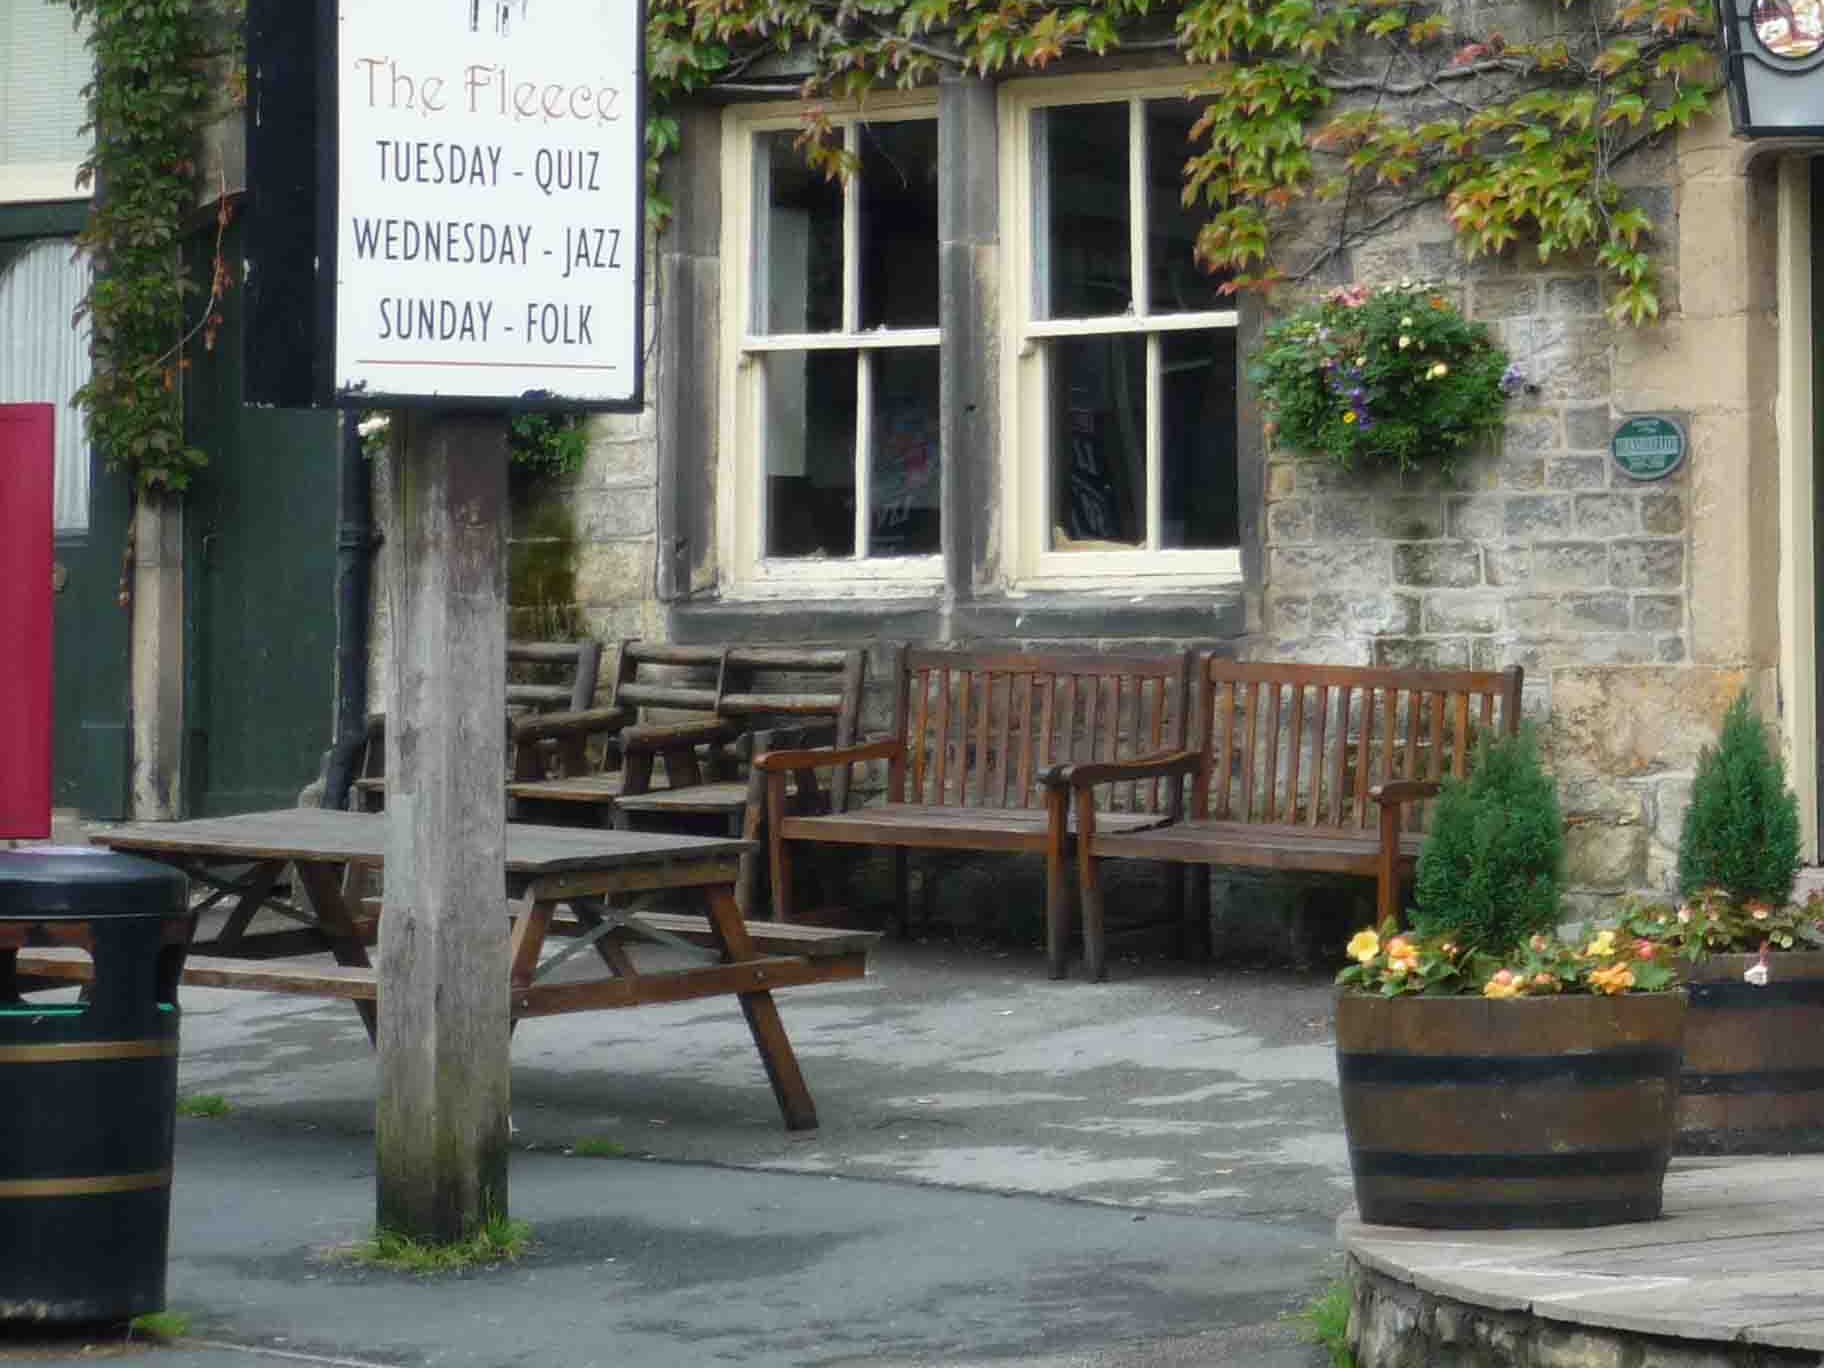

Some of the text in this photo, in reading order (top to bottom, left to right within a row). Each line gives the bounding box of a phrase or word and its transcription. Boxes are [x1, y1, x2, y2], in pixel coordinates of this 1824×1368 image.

[354, 56, 622, 128] The Fleece
[375, 139, 503, 188] TUESDAY
[535, 147, 601, 196] QUIZ
[352, 217, 533, 266] WEDNESDAY
[561, 227, 622, 279] JAZZ
[378, 297, 494, 343] SUNDAY
[527, 303, 593, 345] FOLK
